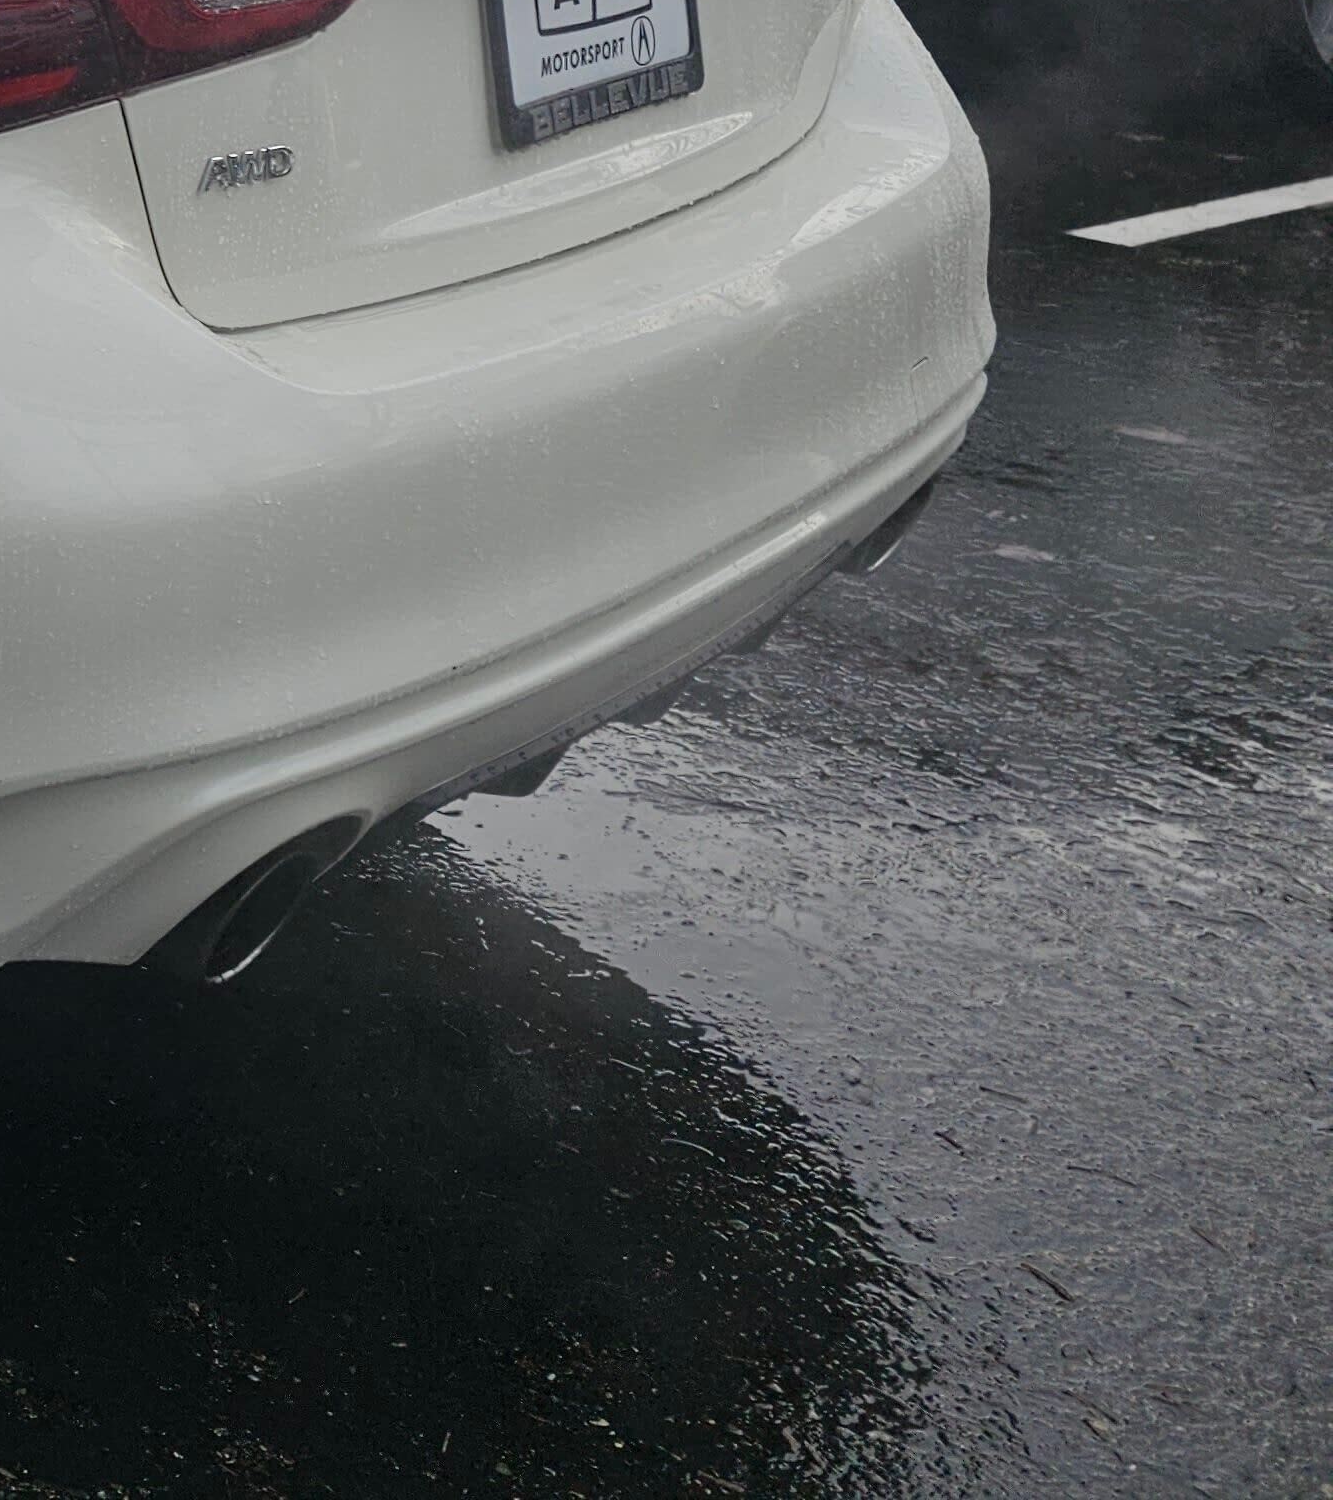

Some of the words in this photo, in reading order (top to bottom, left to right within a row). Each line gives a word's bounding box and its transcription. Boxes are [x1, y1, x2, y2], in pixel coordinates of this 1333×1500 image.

[540, 36, 625, 77] MOTORSPORT
[529, 63, 690, 141] BELLEVUE
[196, 145, 295, 196] AWD
